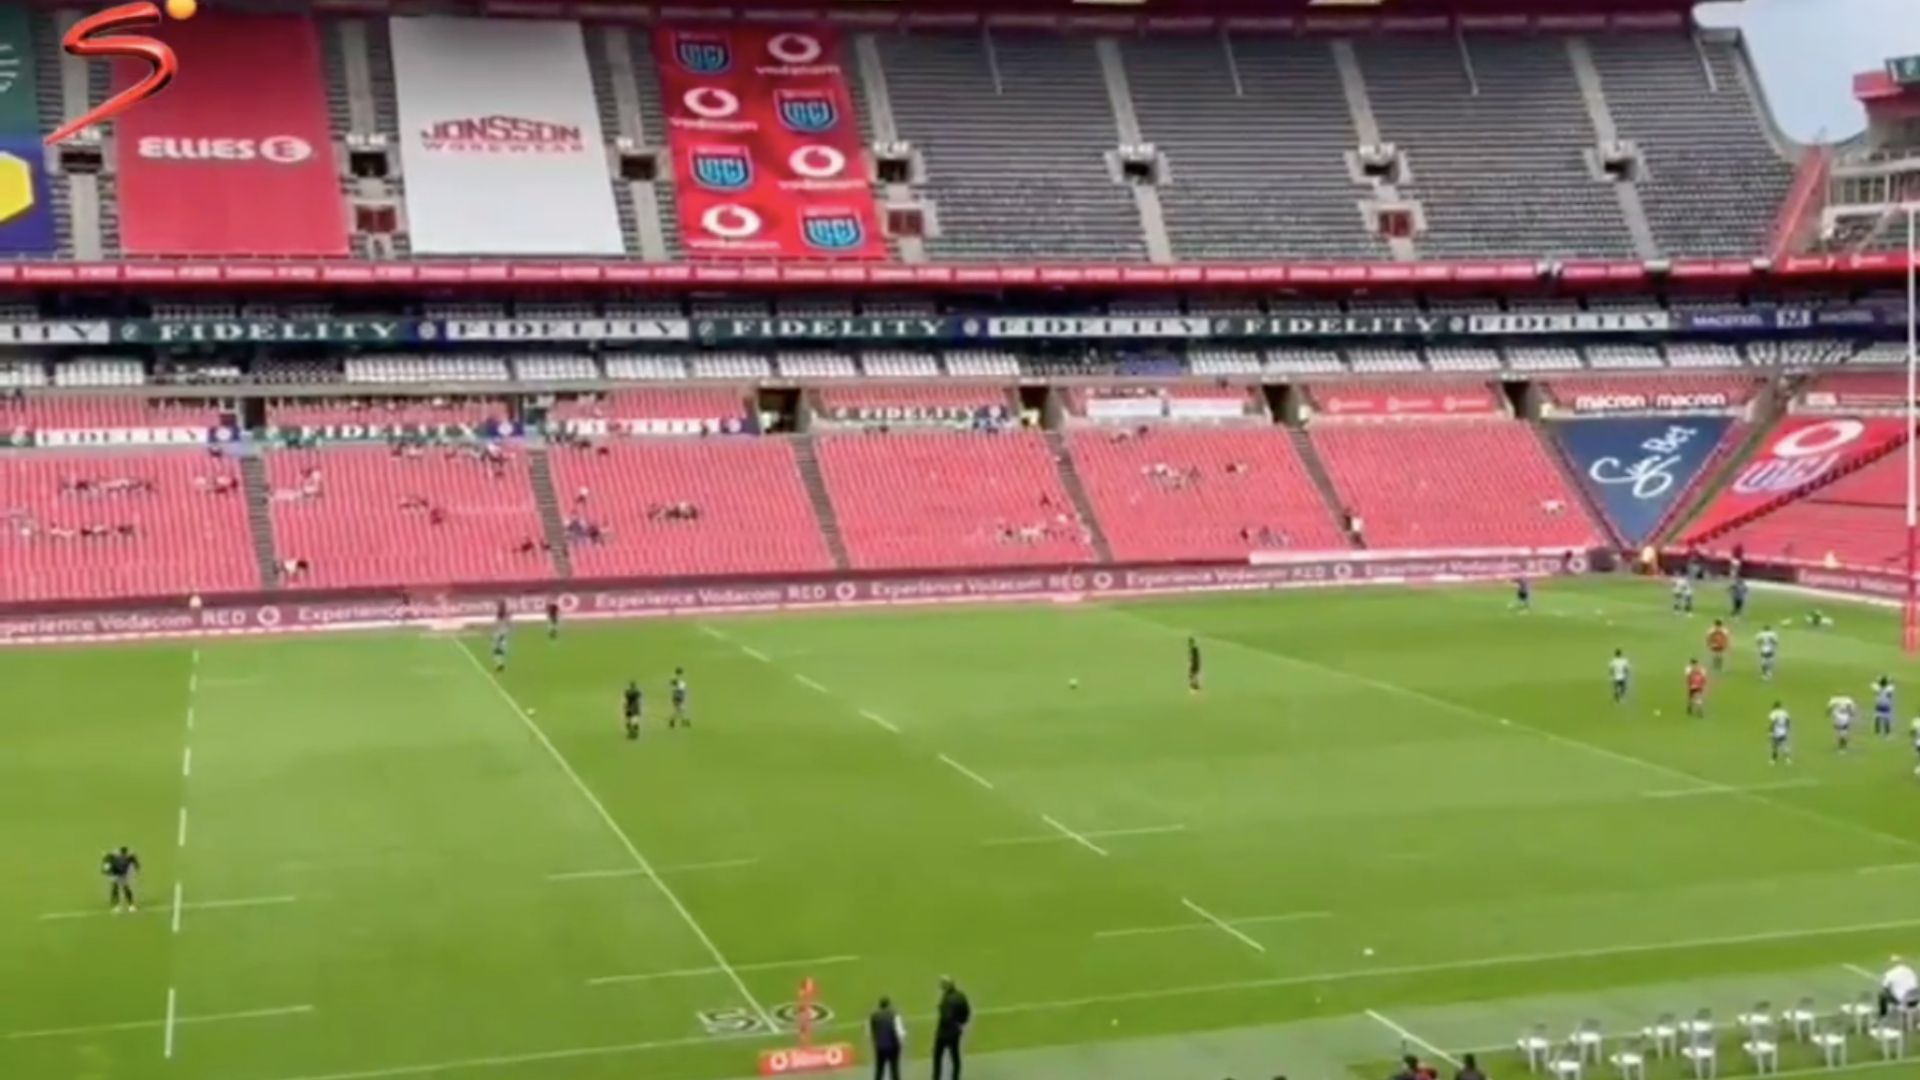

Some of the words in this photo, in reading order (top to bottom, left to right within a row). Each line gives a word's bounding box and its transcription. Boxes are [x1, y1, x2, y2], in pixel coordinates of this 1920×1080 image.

[420, 115, 581, 142] JONSSON
[138, 136, 256, 160] ELLIES
[160, 322, 397, 341] FIDELITY
[731, 318, 943, 337] FIDELITY
[1244, 316, 1438, 335] FIDELITY
[1575, 395, 1646, 411] macron
[1656, 393, 1726, 408] macron
[860, 408, 978, 420] FIDELITY
[593, 591, 695, 611] Experience
[699, 588, 782, 605] Vodacom
[787, 584, 827, 601] RED
[870, 579, 963, 601] Experience
[966, 575, 1043, 595] Vodacom
[99, 609, 193, 632] Vodacom
[201, 608, 246, 627] RED
